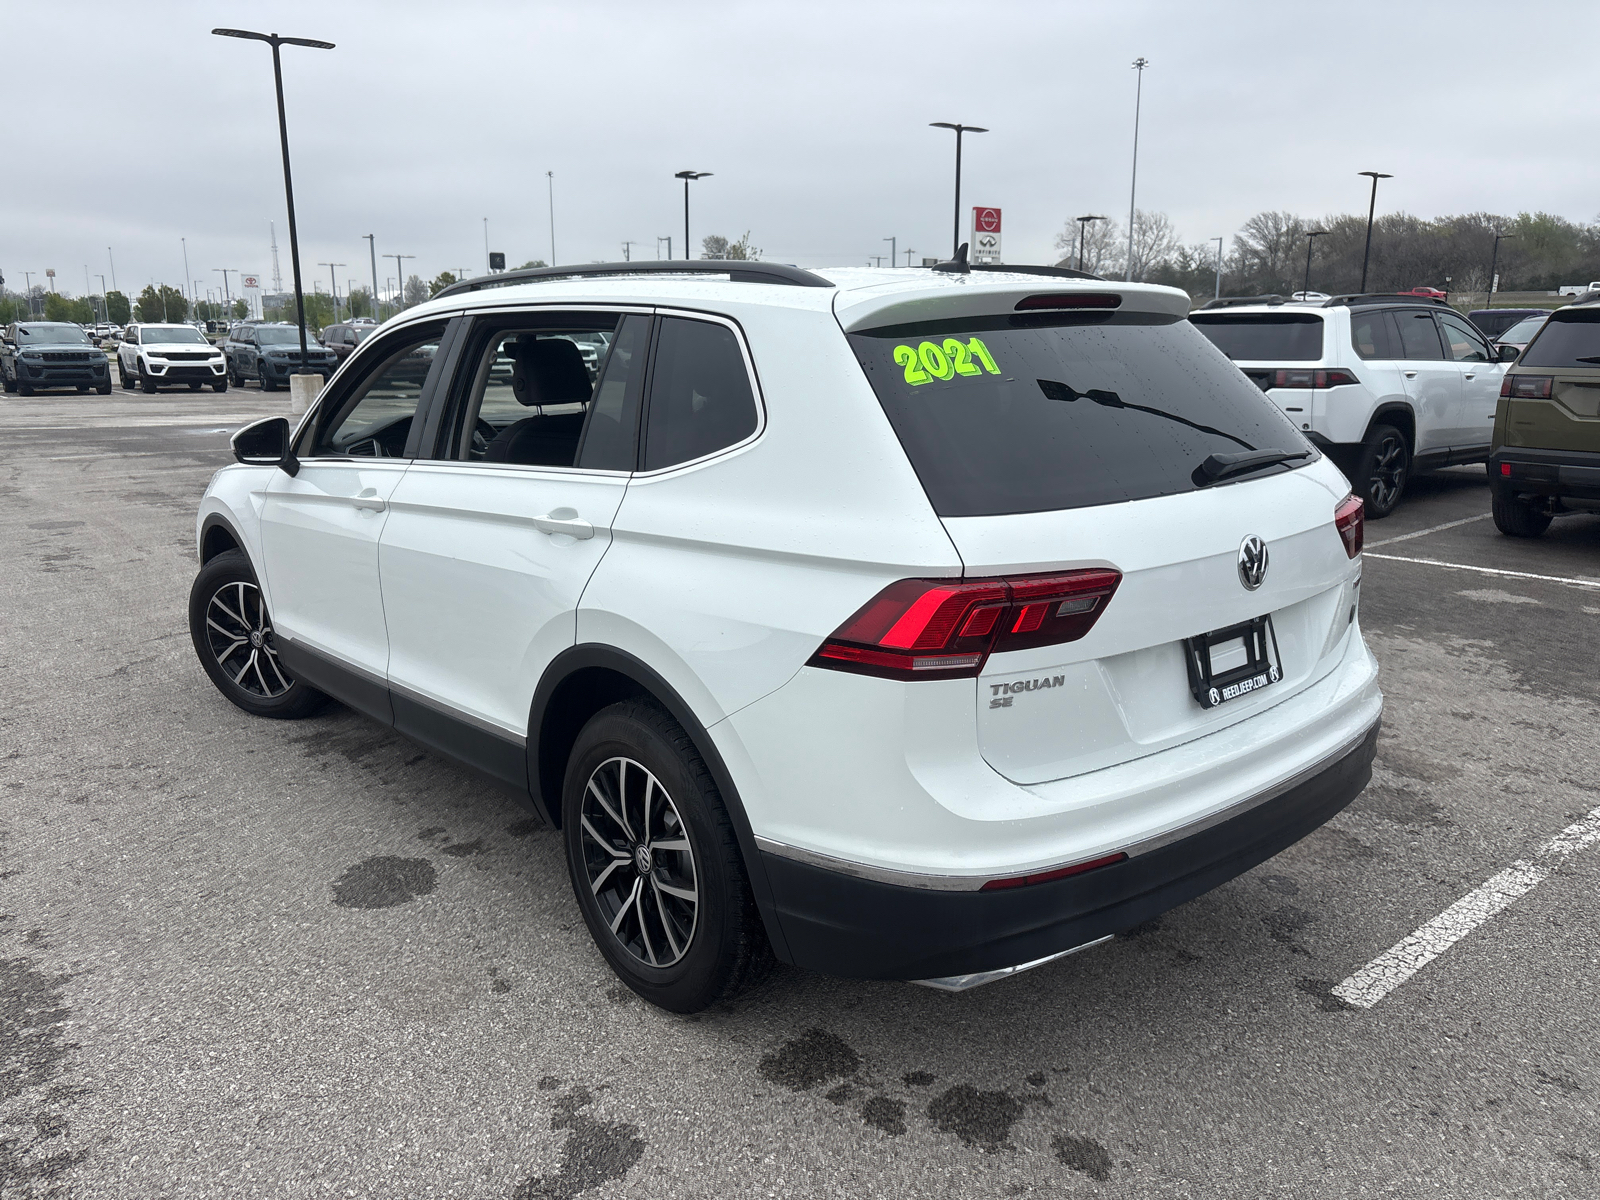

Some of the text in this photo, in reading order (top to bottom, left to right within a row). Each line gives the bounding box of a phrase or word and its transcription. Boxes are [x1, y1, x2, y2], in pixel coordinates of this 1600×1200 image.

[893, 337, 1002, 386] 2021
[990, 675, 1065, 696] TIGUAN
[1222, 674, 1268, 700] REEDJEEP.COM
[989, 697, 1013, 709] SE
